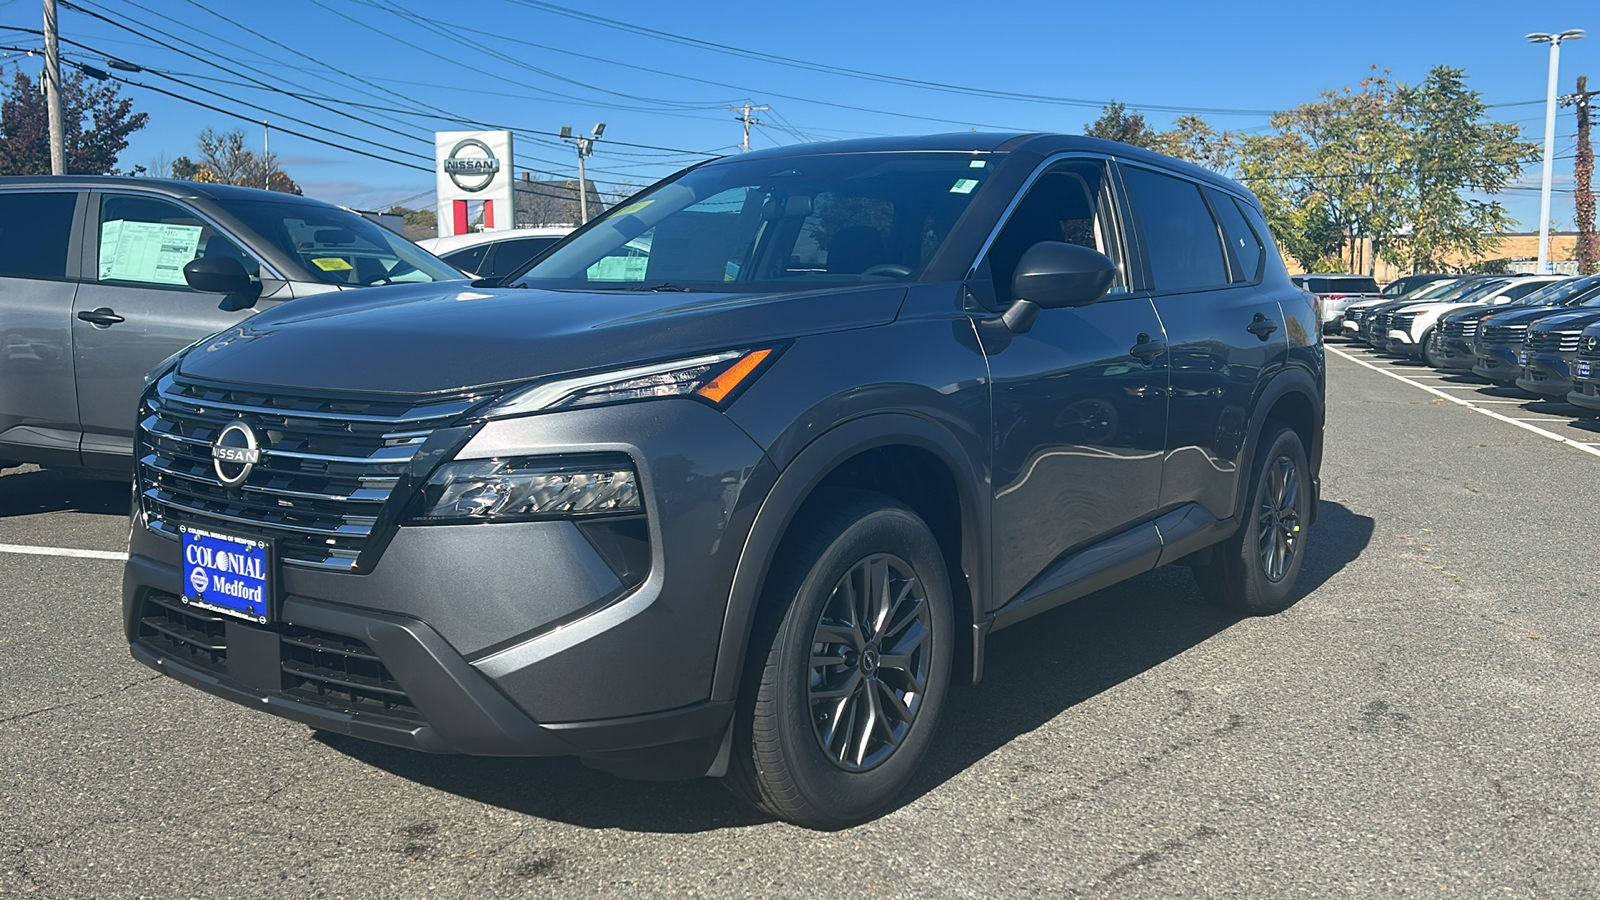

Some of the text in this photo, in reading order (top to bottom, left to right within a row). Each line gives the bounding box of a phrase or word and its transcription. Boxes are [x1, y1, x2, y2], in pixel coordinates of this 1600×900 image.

[447, 160, 493, 169] NISSAN
[211, 447, 257, 464] NISSAN
[186, 544, 266, 580] COLONIAL
[213, 575, 262, 602] Medford
